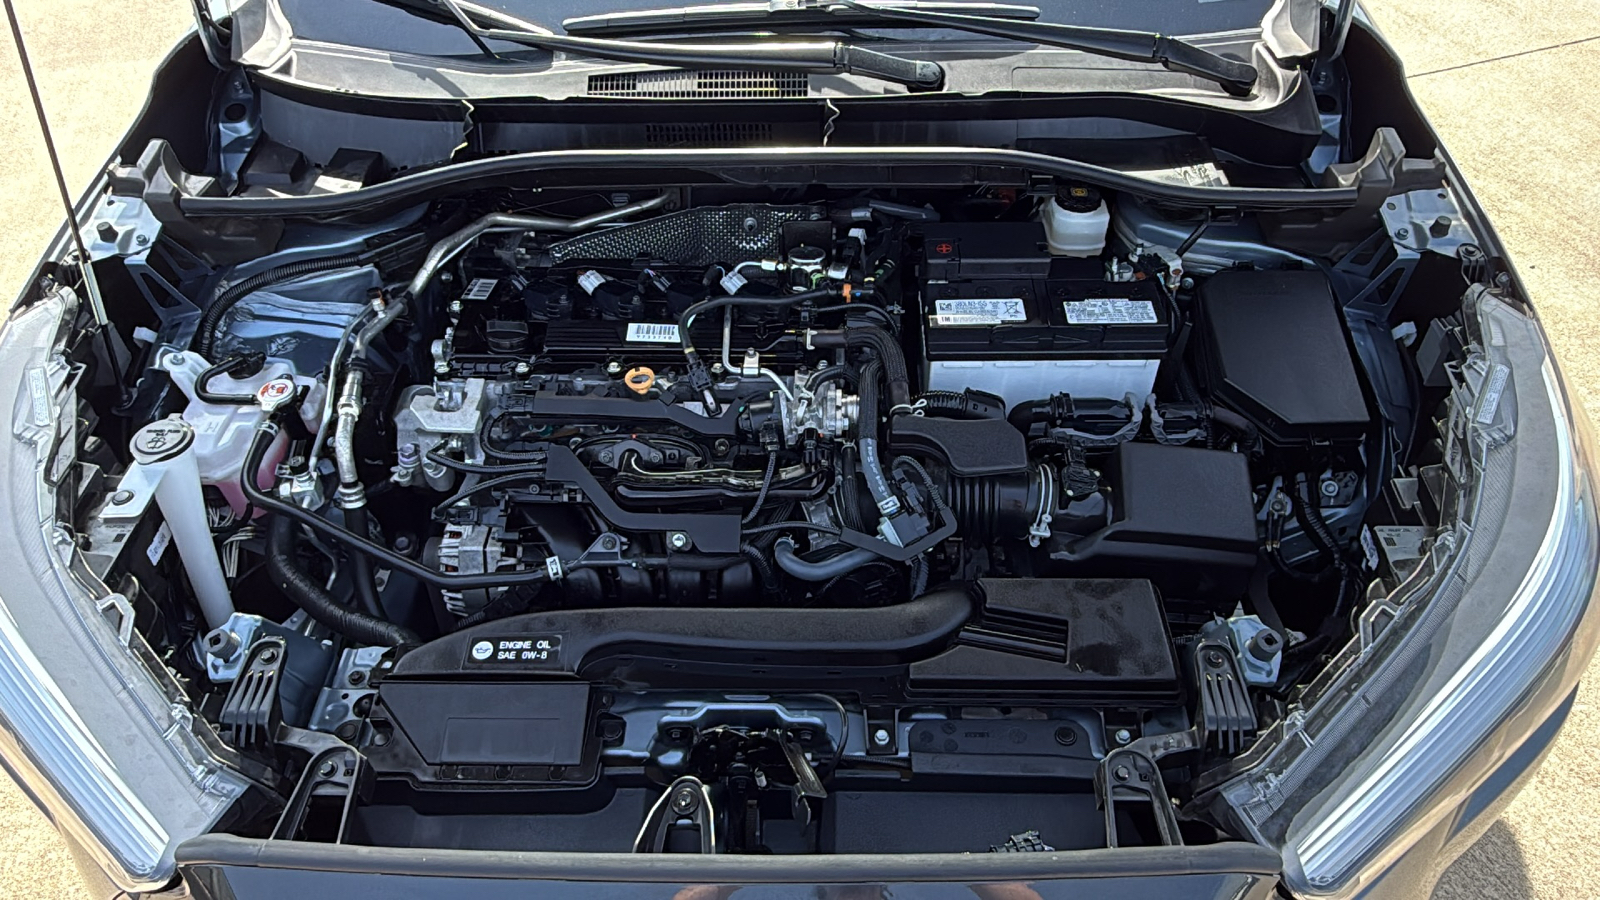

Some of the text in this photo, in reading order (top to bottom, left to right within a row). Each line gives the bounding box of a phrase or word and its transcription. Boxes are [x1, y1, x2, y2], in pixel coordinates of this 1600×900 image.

[499, 640, 551, 649] ENGINE OIL
[497, 651, 548, 660] SAE 0W-8
